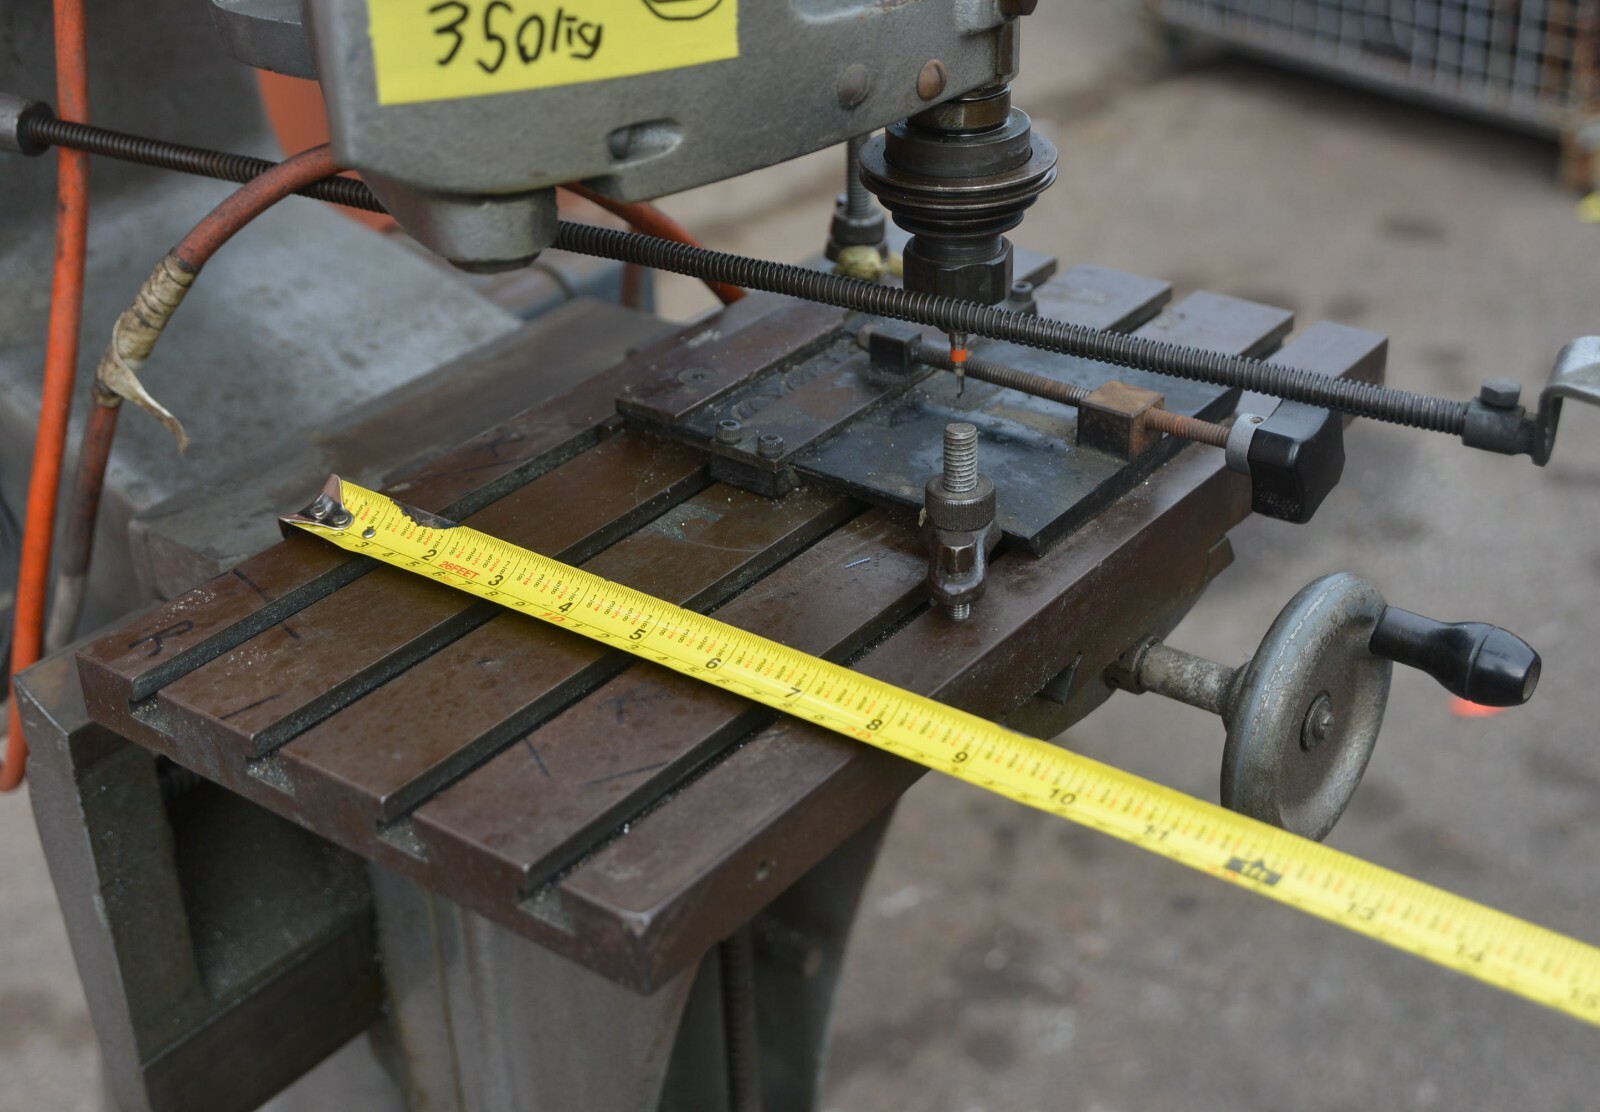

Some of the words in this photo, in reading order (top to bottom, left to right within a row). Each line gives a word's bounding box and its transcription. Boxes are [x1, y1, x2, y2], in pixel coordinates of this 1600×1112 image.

[439, 560, 480, 579] 26FEET
[421, 549, 437, 561] 2
[488, 574, 504, 586] 3
[558, 602, 573, 613] 4
[629, 628, 647, 640] 5
[705, 657, 722, 669] 6
[784, 687, 802, 698] 7
[866, 719, 883, 731] 8
[952, 751, 968, 763] 9
[1048, 788, 1076, 805] 10
